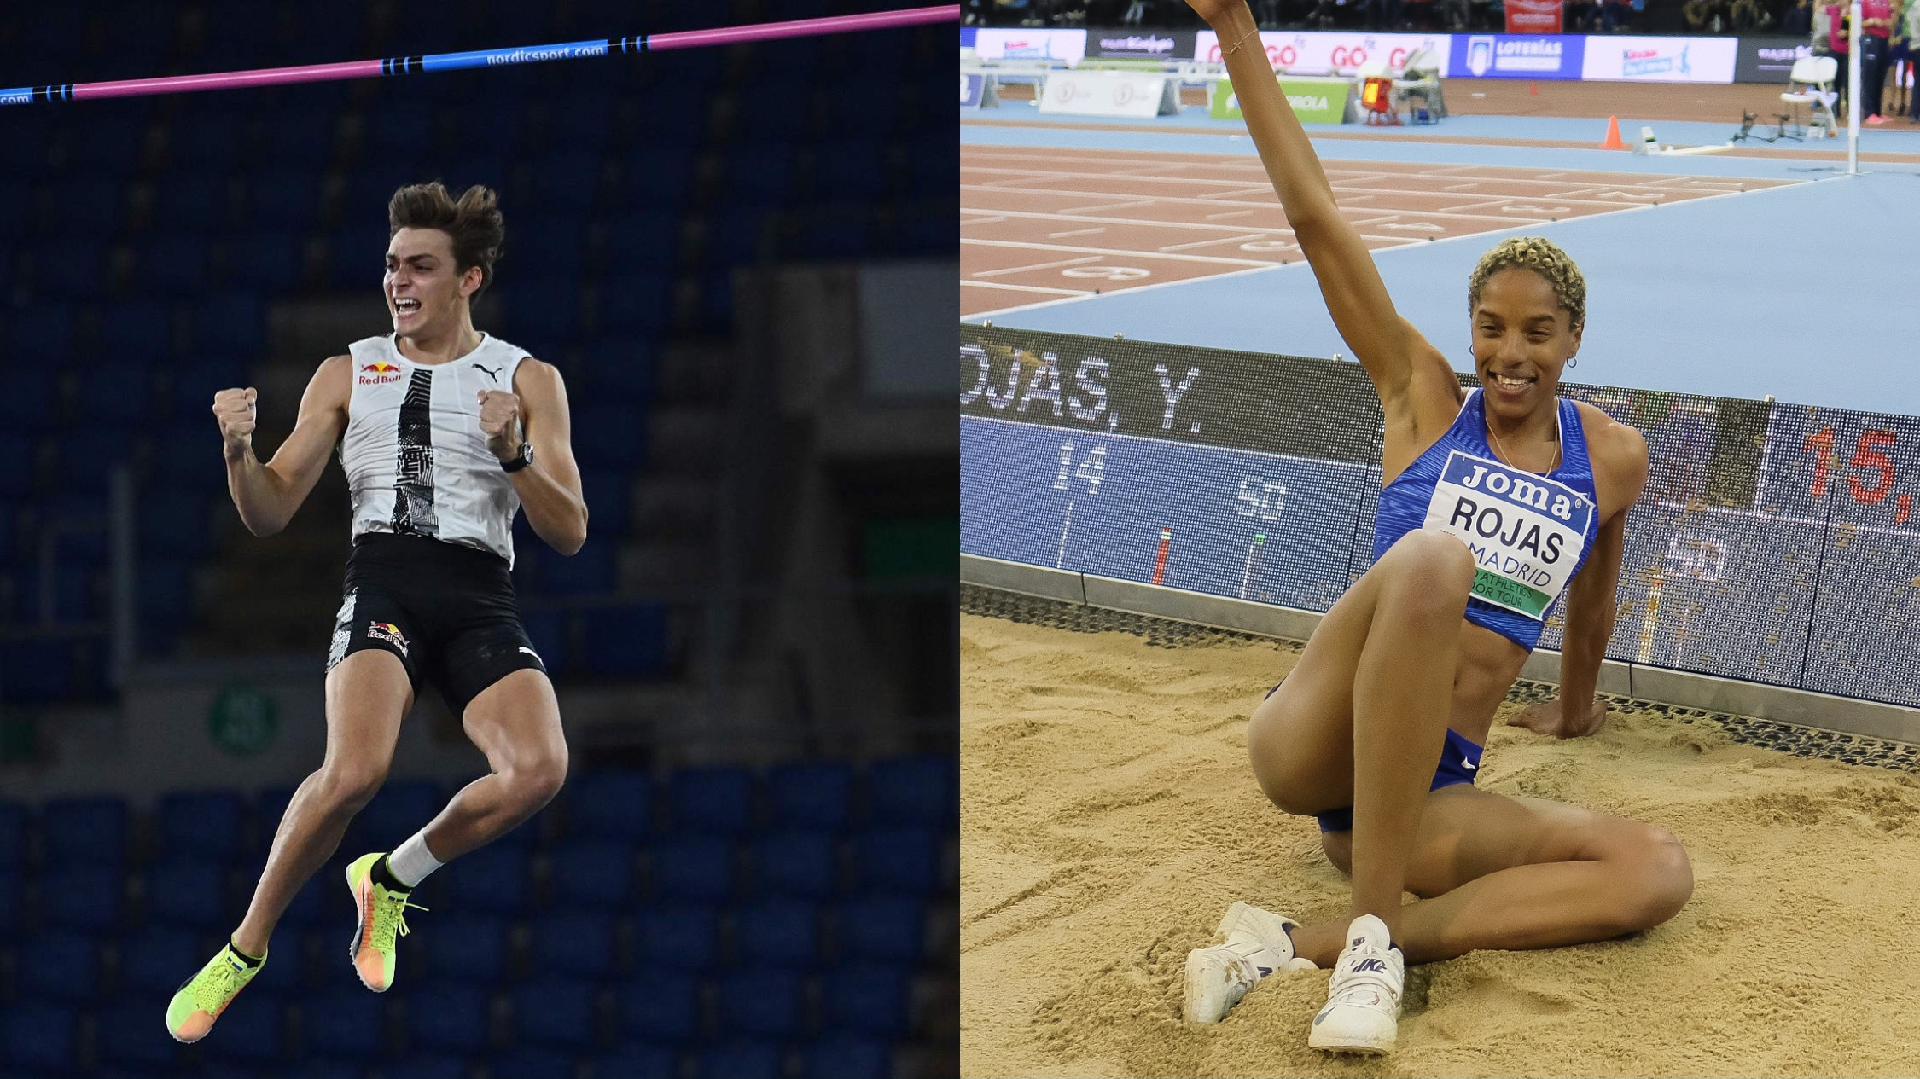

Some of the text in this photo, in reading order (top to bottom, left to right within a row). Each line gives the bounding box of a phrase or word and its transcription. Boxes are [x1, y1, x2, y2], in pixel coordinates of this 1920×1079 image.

[487, 46, 604, 66] nordicsport.com
[1331, 45, 1367, 67] GO
[1154, 363, 1201, 433] Y.
[1053, 436, 1107, 495] 14
[1803, 425, 1912, 525] 15,
[1449, 496, 1564, 565] ROJAS
[1469, 542, 1551, 587] MADRID
[1480, 572, 1534, 599] ATHLETICS
[1497, 590, 1523, 607] TOUR
